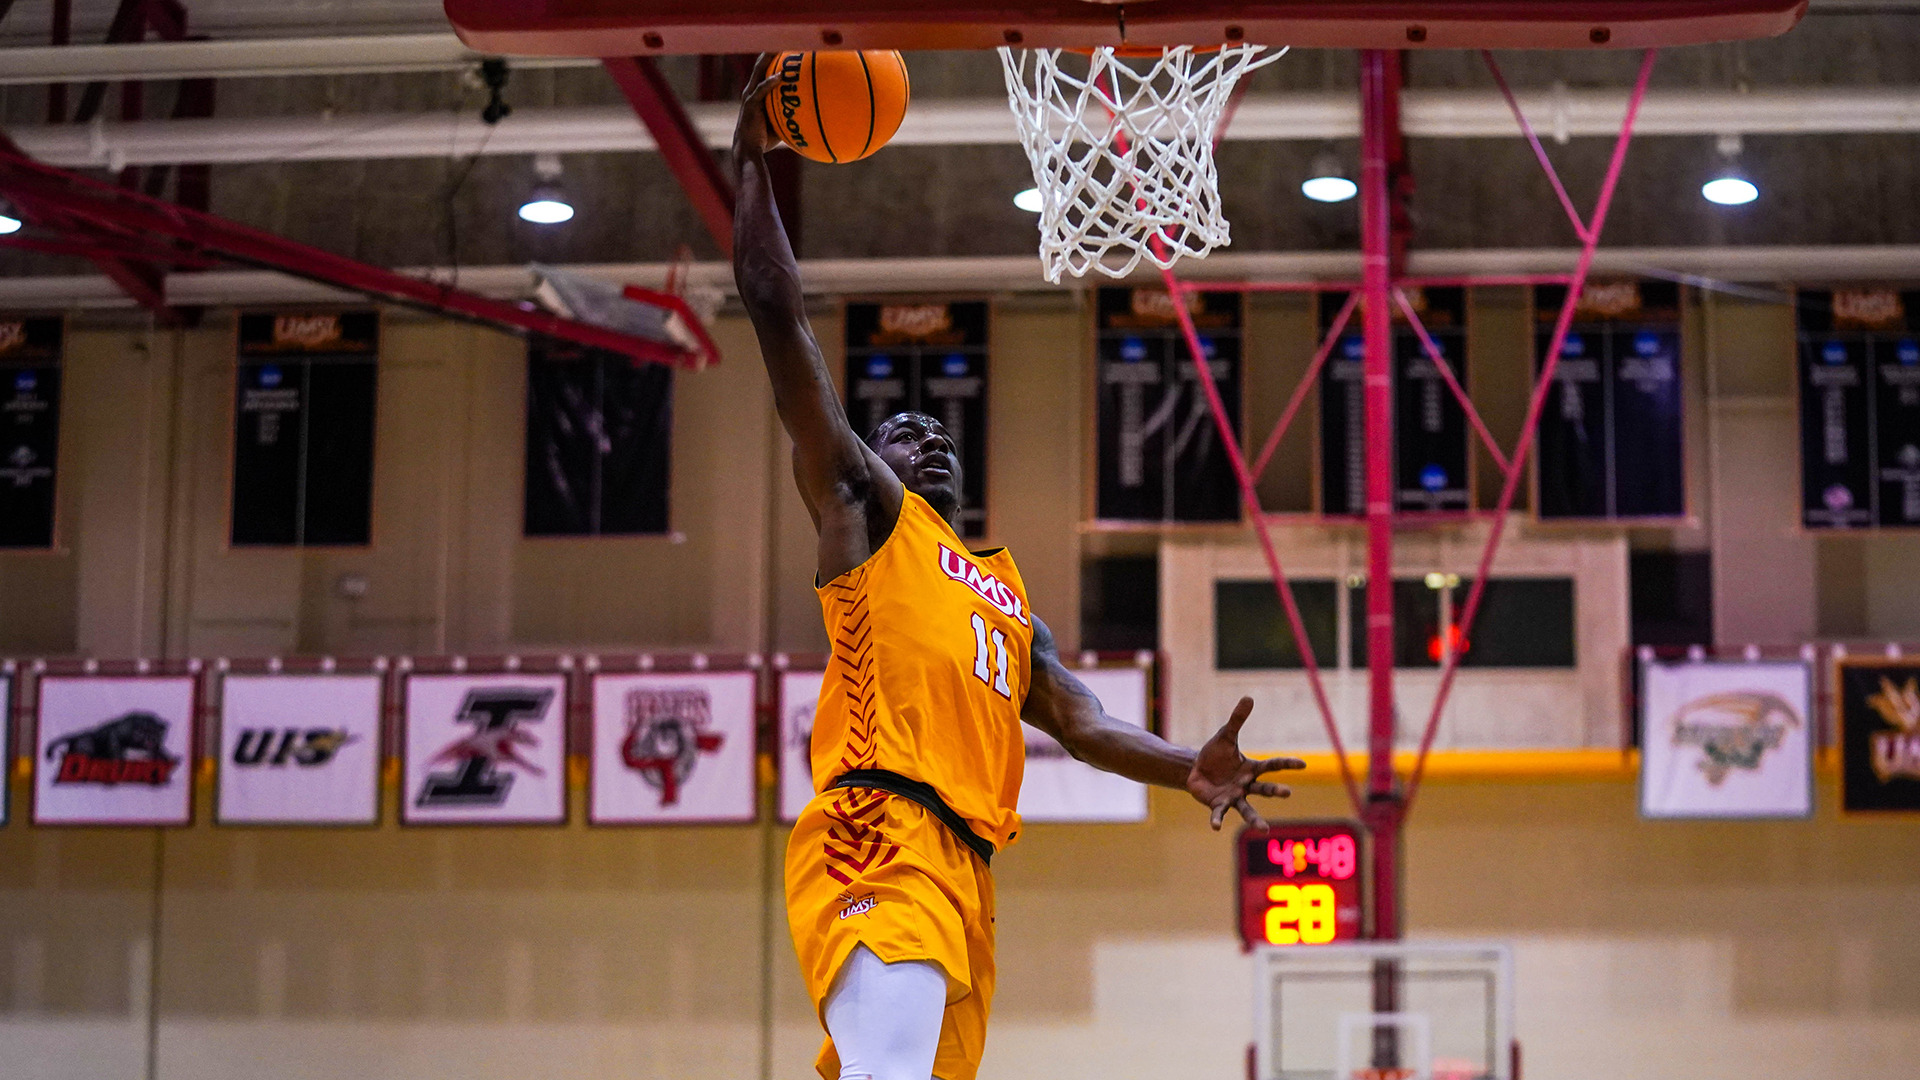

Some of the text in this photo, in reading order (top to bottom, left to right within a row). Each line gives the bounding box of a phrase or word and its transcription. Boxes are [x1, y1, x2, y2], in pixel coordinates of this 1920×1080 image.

[780, 53, 808, 147] Wilson
[938, 542, 1029, 627] UMSL
[970, 611, 1012, 701] 11
[1267, 834, 1356, 880] 4:48
[839, 897, 878, 920] UMSL
[1265, 883, 1336, 946] 28
